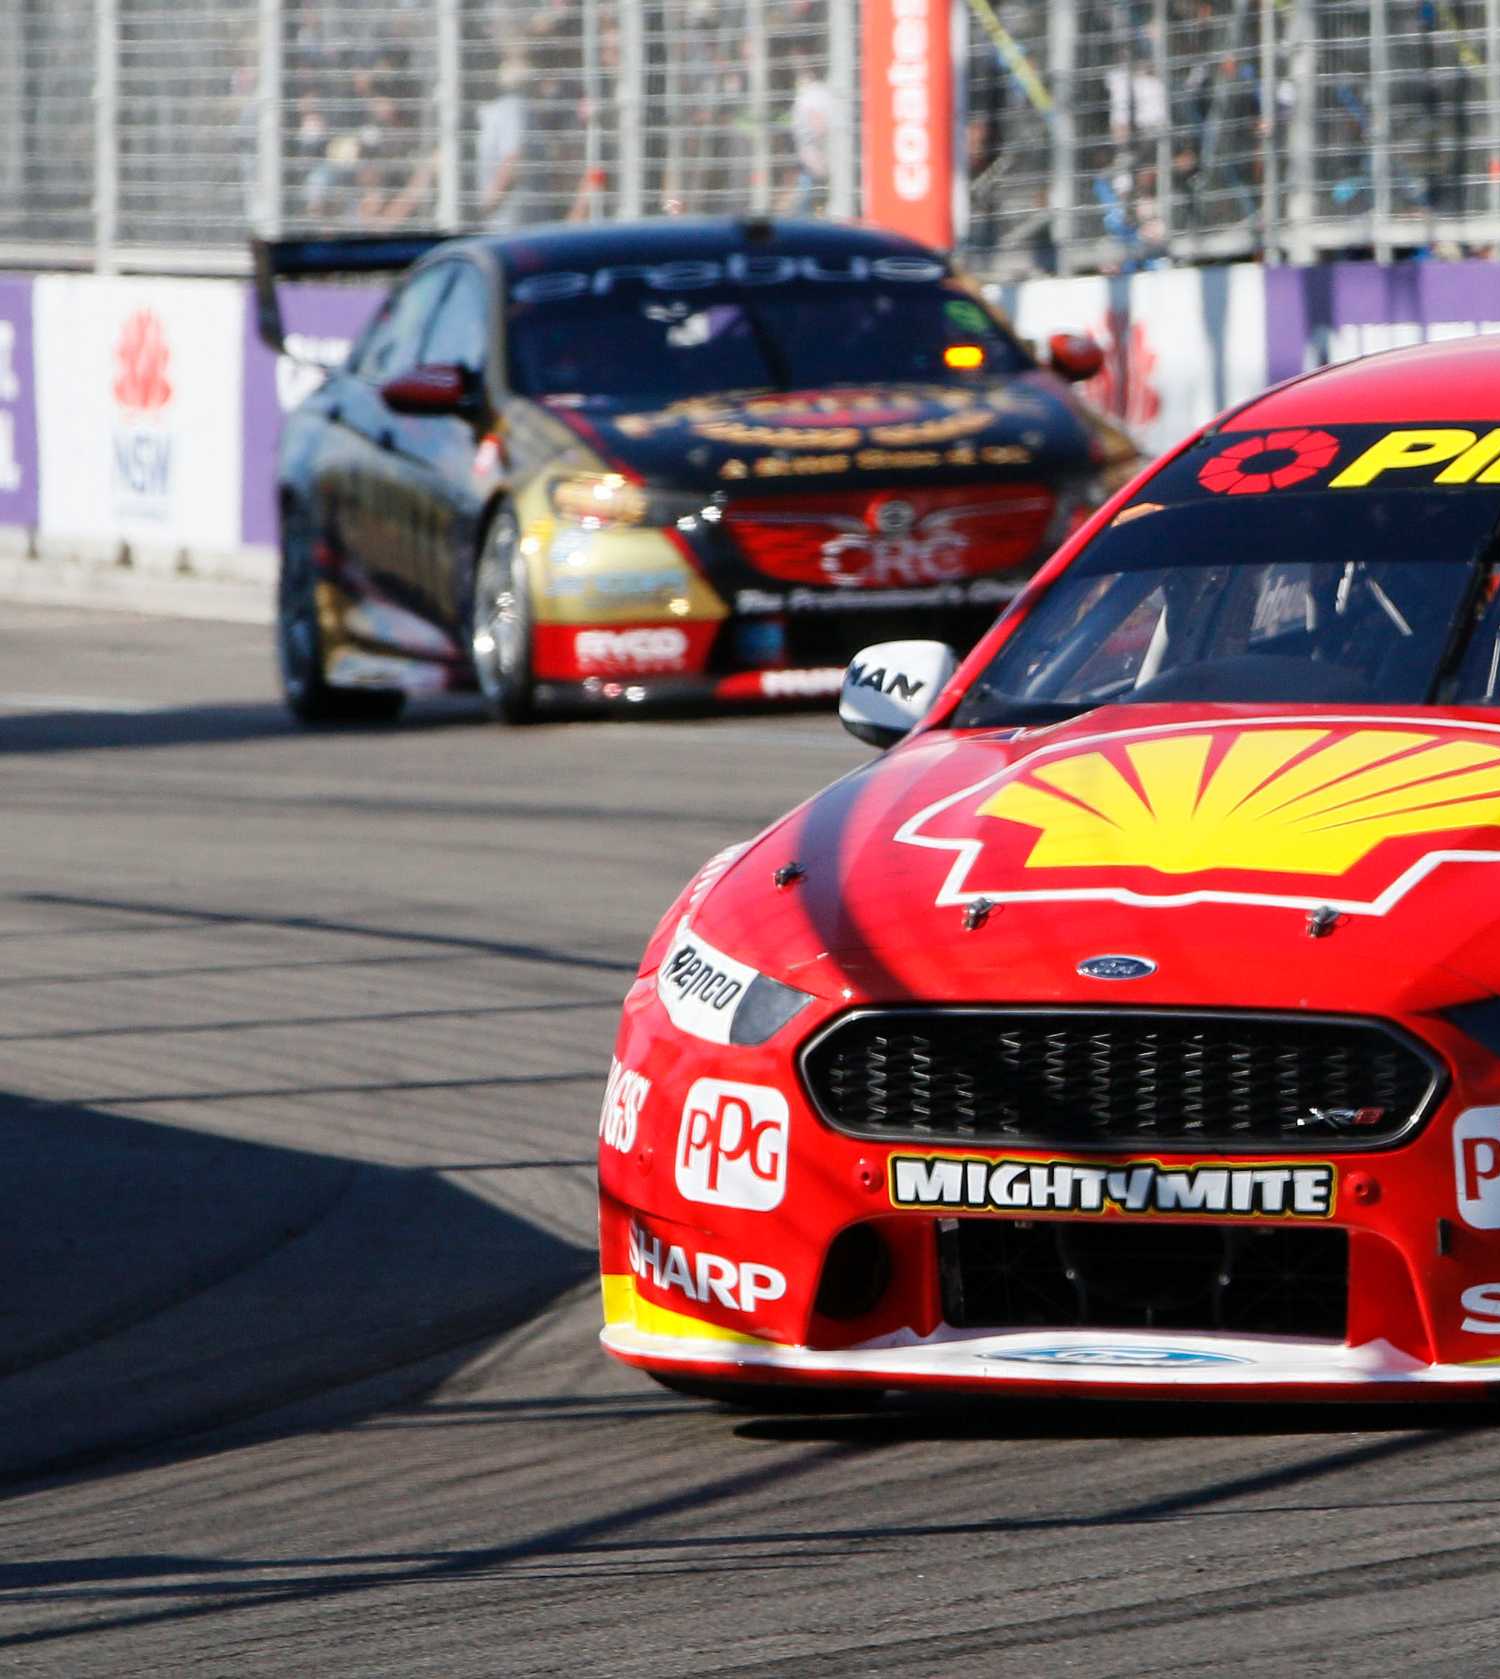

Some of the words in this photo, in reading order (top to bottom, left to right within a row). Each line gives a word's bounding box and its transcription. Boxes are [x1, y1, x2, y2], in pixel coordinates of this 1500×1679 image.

[575, 627, 688, 665] RYCO
[848, 662, 924, 698] MAN
[662, 945, 742, 1011] Repco
[683, 1094, 781, 1191] PPG
[628, 1216, 787, 1313] SHARP
